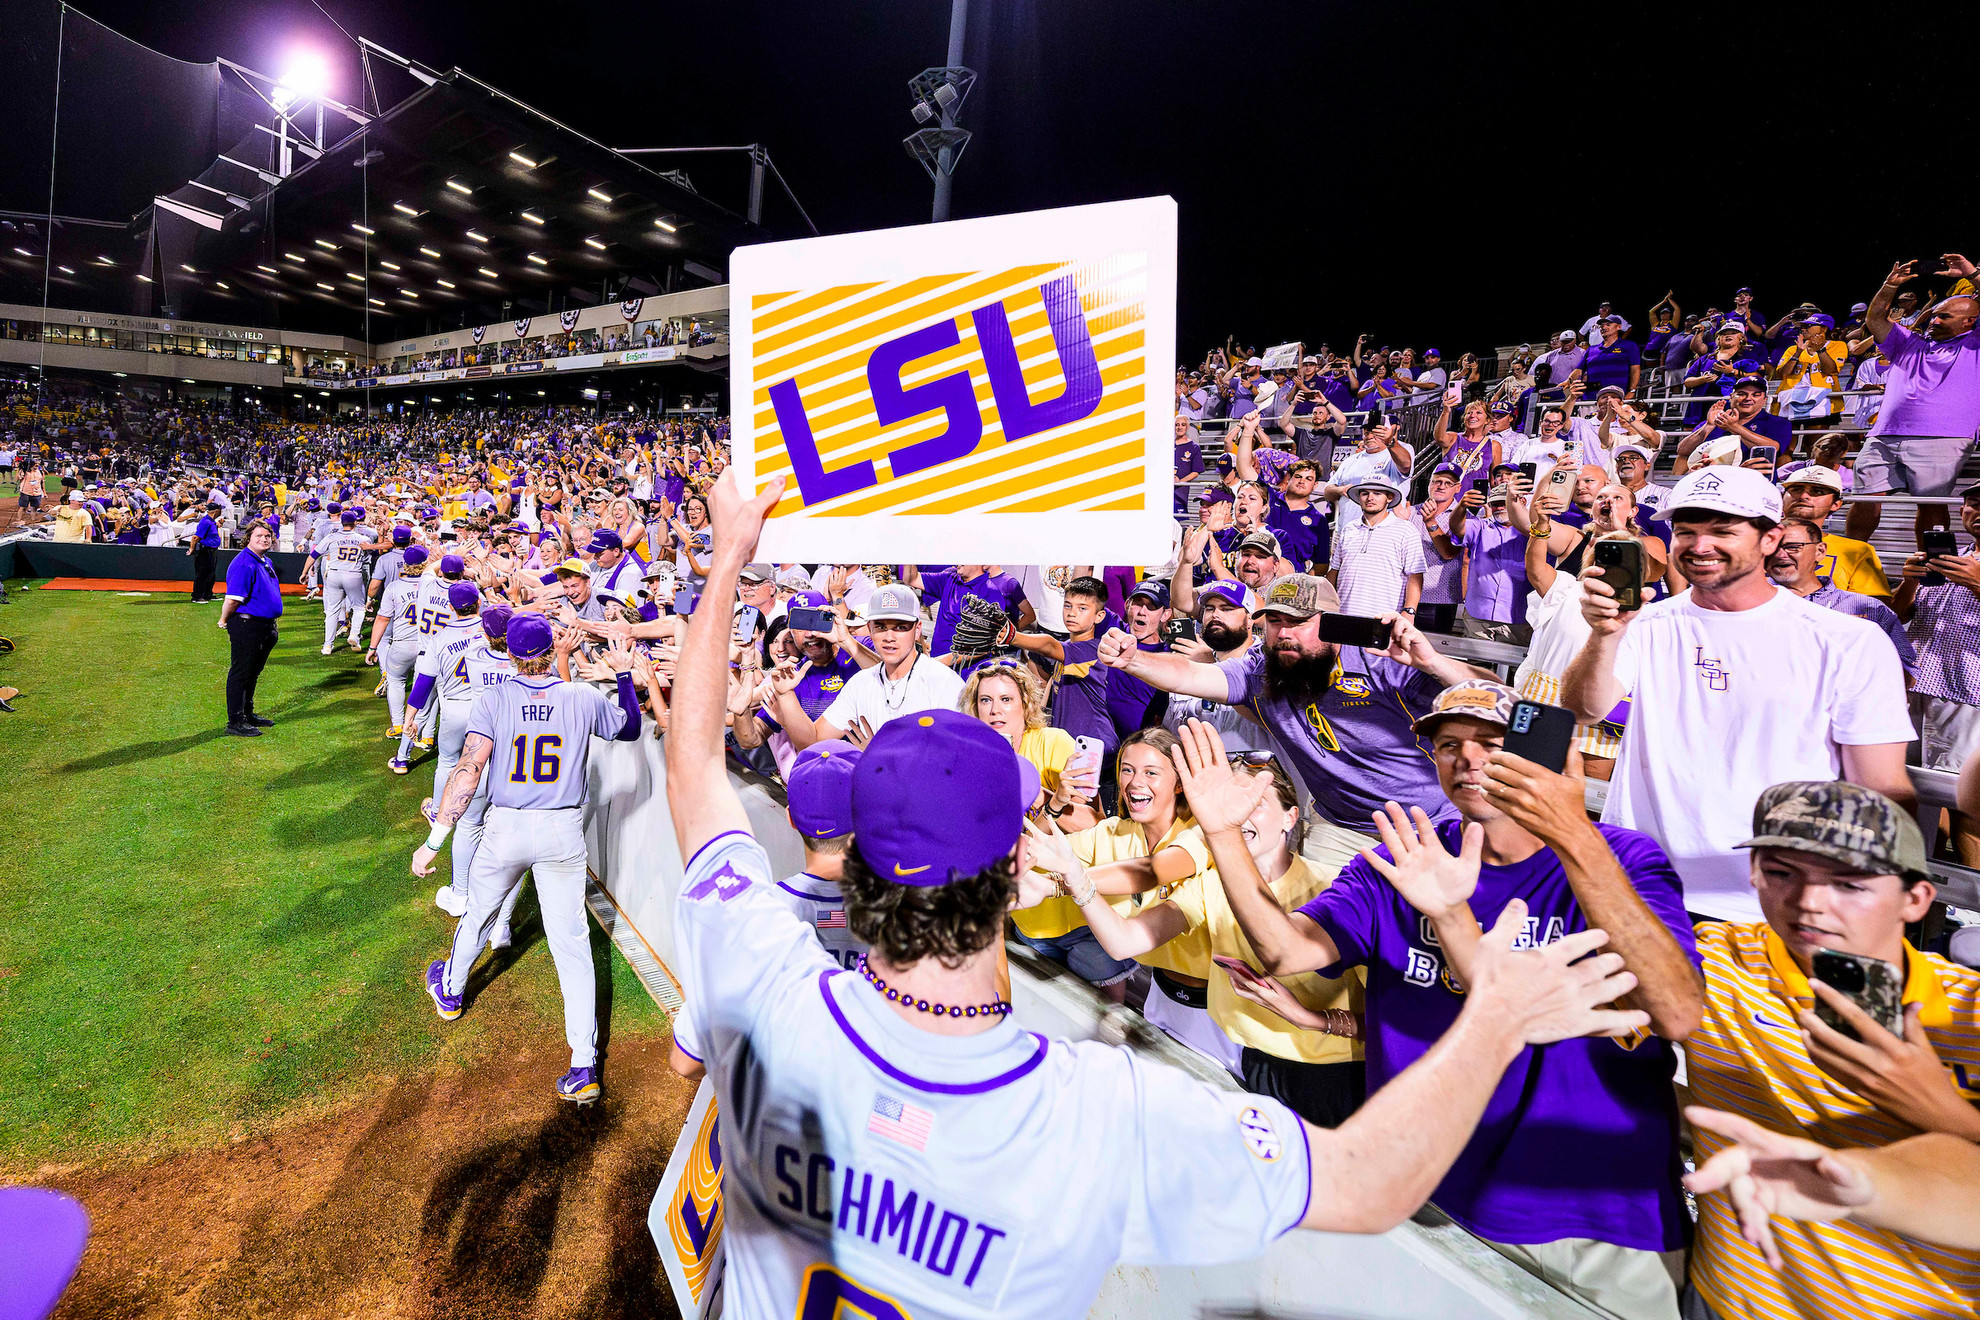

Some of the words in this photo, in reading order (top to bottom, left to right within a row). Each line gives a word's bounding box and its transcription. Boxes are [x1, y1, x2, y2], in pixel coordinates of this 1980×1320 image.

[768, 273, 1103, 506] LSU
[1694, 481, 1720, 492] SR
[337, 547, 359, 562] 52
[429, 595, 450, 609] WARE
[419, 608, 451, 635] 55
[521, 704, 555, 722] FREY
[509, 733, 563, 785] 16
[1176, 989, 1190, 1001] alo
[774, 1143, 1007, 1290] SCHMIDT
